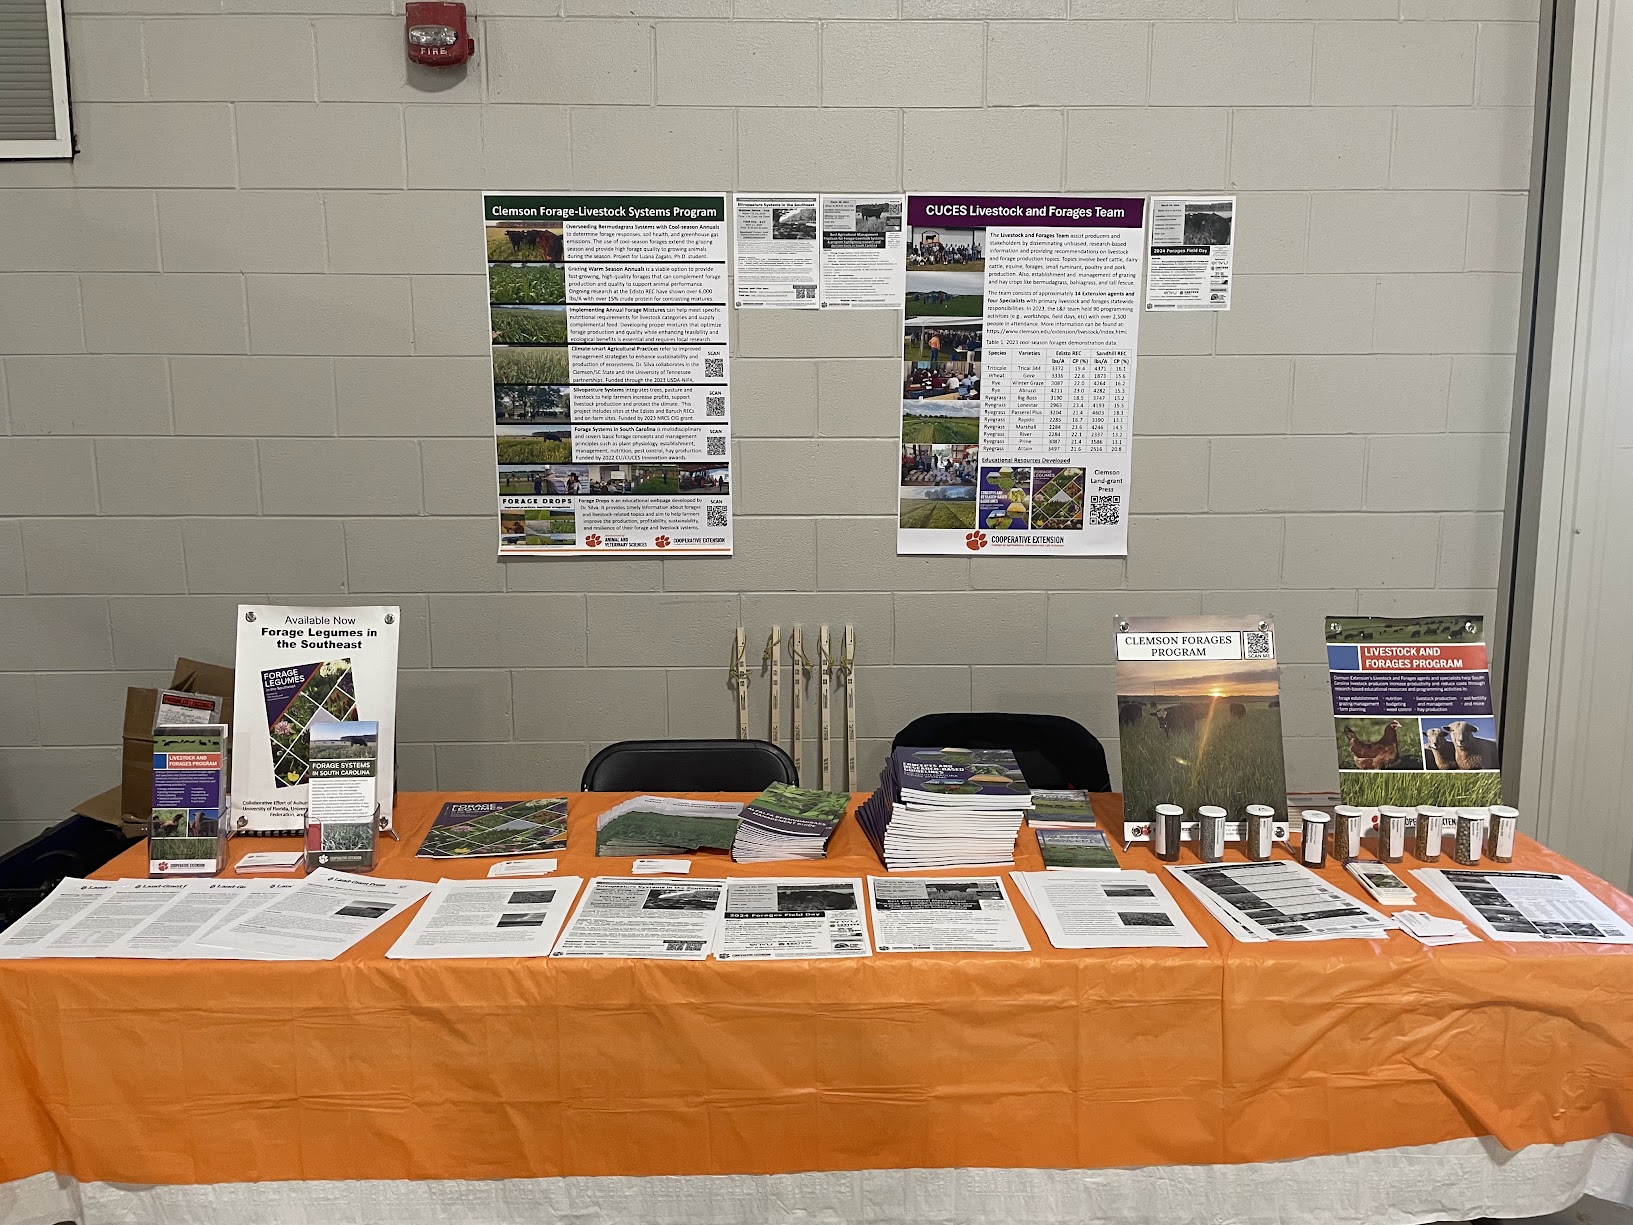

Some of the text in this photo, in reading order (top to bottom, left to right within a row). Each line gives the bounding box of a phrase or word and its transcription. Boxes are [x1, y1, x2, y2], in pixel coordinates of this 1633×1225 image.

[492, 207, 716, 218] Clemson Forage-Livestock Systems Program
[926, 205, 1124, 219] CUCES Livestock and Forages Team
[992, 536, 1064, 544] COOPERATIVE EXTENSION
[285, 616, 356, 625] Available Now
[262, 628, 377, 639] Forage Legumes in
[277, 640, 362, 649] the Southeast
[1125, 636, 1232, 645] CLEMSON FORAGES
[1151, 648, 1206, 657] PROGRAM
[1365, 648, 1440, 656] LIVESTOCK AND
[1366, 660, 1463, 668] FORAGES PROGRAM
[264, 669, 298, 680] FORAGE
[265, 675, 305, 687] LEGUMES
